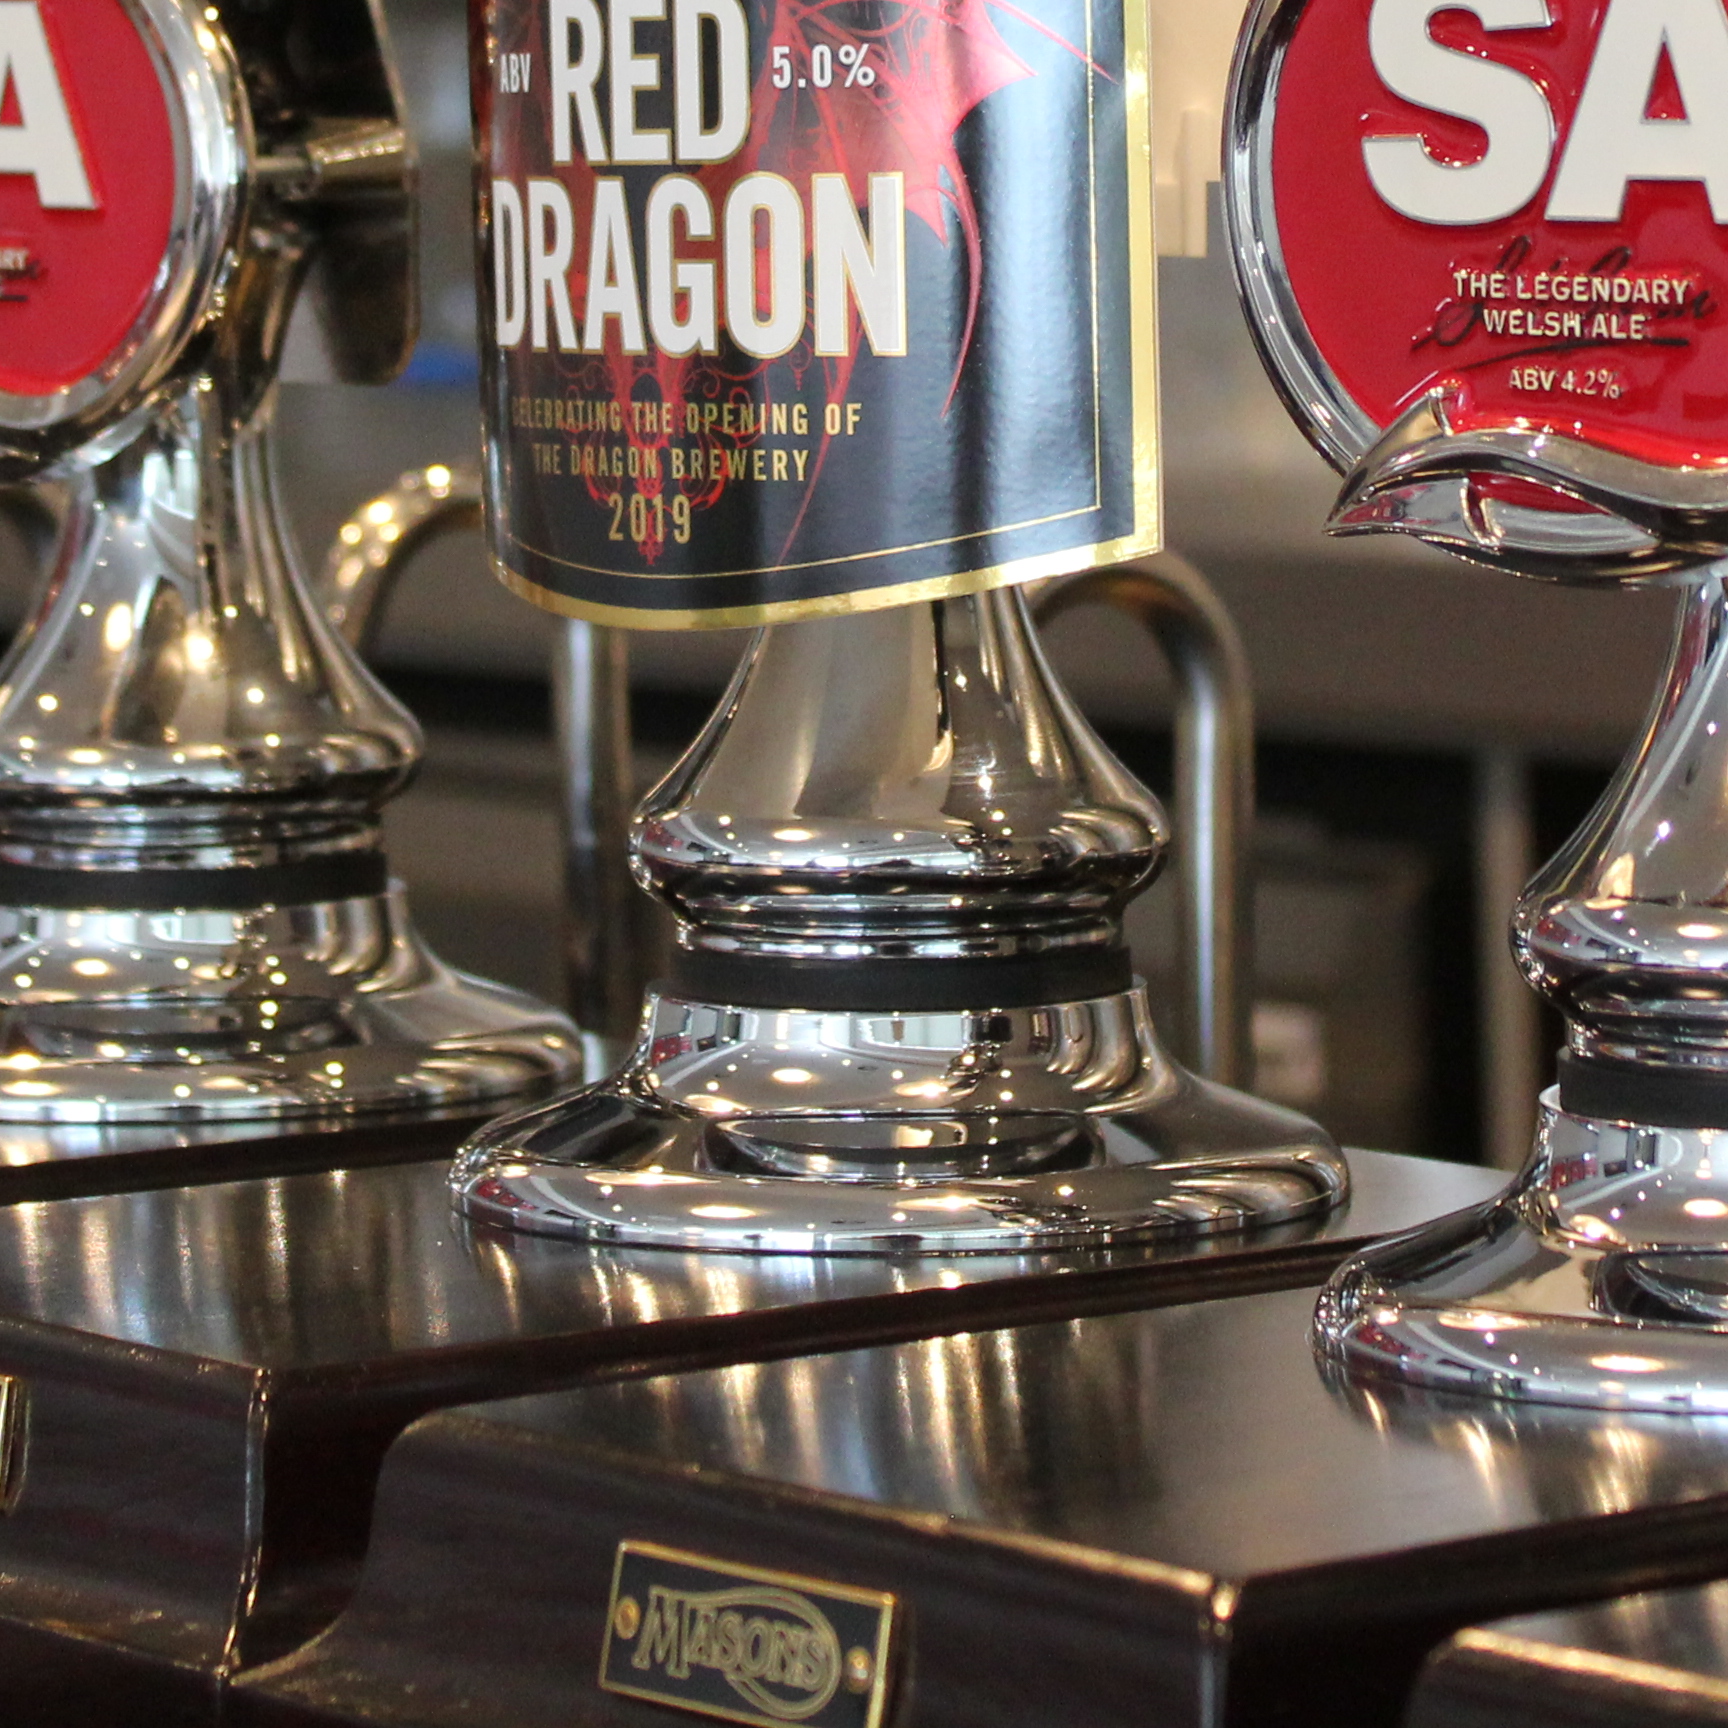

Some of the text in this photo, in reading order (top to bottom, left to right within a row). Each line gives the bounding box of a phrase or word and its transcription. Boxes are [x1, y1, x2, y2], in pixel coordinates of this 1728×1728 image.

[500, 53, 531, 94] ABV
[771, 42, 876, 90] 5.0%
[491, 170, 909, 360] DRAGON
[1453, 270, 1689, 305] THE LEGENDARY
[1483, 309, 1648, 340] WELSH ALE
[1509, 368, 1622, 400] ABV 4.2%
[512, 397, 863, 436] CELEBRATING THE OPENING OF
[532, 443, 810, 482] THE DRAGON BREWERY
[608, 492, 691, 545] 2019
[632, 1585, 842, 1719] MASONS
